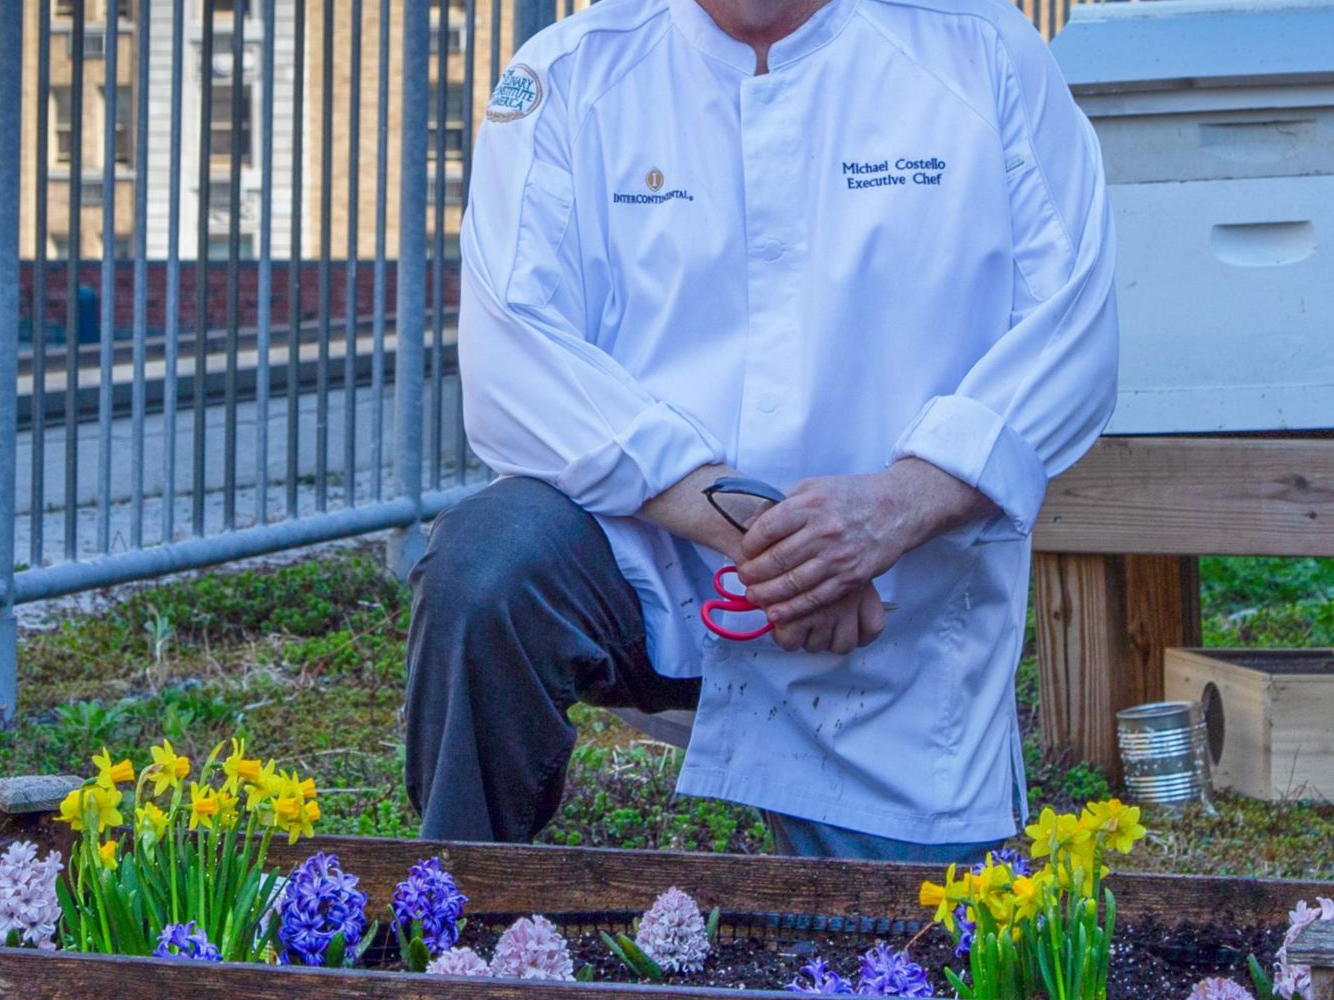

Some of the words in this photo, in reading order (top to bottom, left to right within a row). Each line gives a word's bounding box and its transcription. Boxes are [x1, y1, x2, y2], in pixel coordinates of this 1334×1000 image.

[842, 160, 888, 175] Michael
[895, 157, 946, 170] Costello
[847, 174, 906, 190] Executive
[912, 172, 943, 185] Chef
